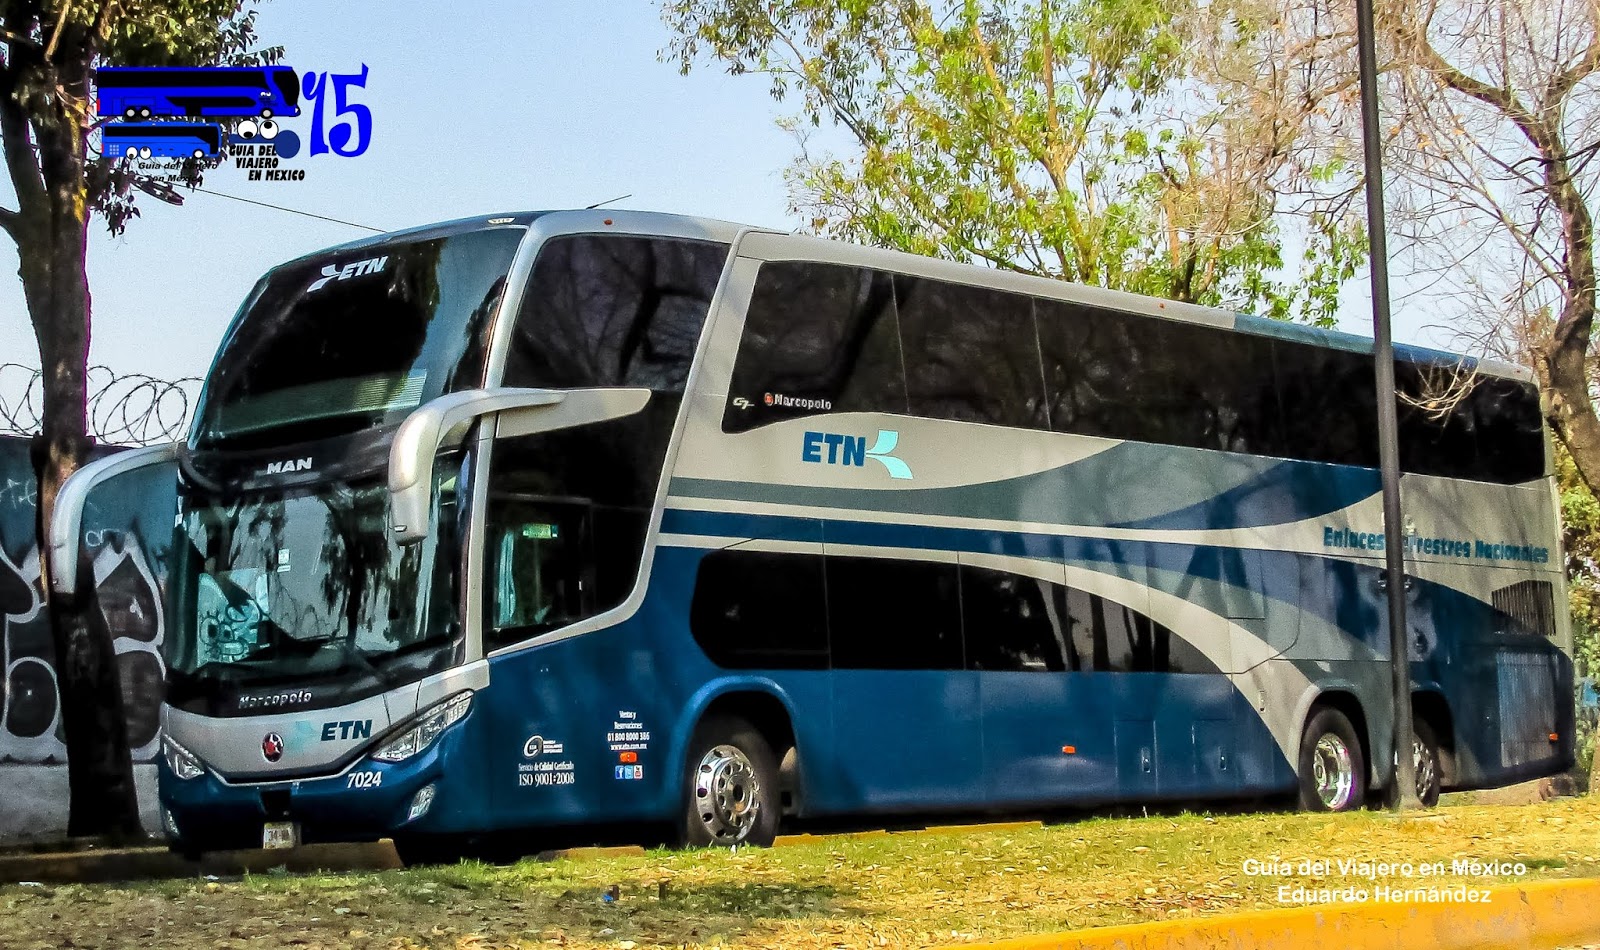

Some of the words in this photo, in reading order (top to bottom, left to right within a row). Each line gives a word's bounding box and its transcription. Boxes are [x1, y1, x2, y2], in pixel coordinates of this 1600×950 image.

[338, 256, 389, 280] ETN
[774, 393, 832, 410] Marcopolo
[802, 431, 866, 466] ETN
[266, 457, 313, 474] MAN
[1323, 526, 1385, 551] Enlaces
[1402, 534, 1471, 558] restres
[1475, 540, 1549, 563] Nacionales
[238, 690, 312, 709] Marcopolo
[321, 720, 372, 741] ETN
[607, 733, 615, 742] 01
[347, 771, 382, 789] 7024
[519, 773, 534, 787] ISO
[534, 772, 575, 788] 9001:2008
